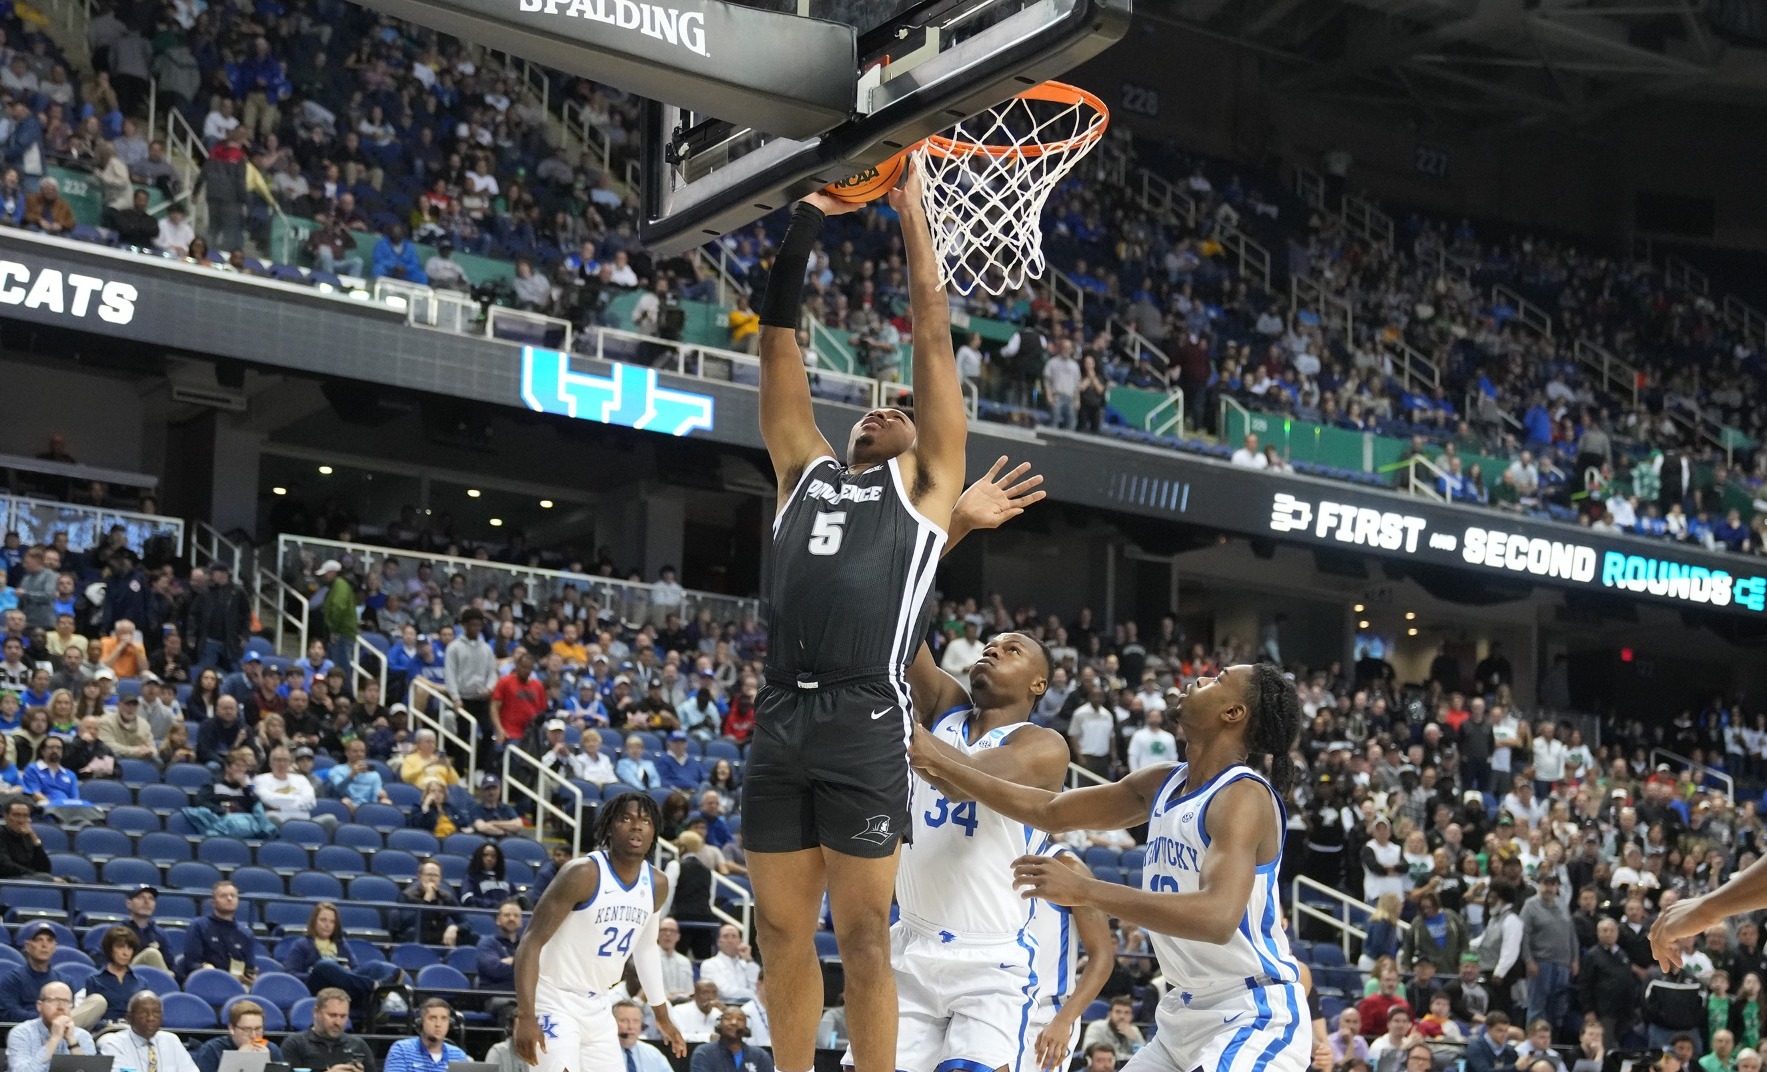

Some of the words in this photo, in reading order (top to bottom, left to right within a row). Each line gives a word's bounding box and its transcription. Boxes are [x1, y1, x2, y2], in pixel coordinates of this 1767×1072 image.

[1121, 84, 1159, 116] 228
[834, 166, 880, 189] NCAA
[0, 260, 138, 325] CATS
[808, 511, 847, 555] 5
[1316, 501, 1427, 553] FIRST
[1462, 527, 1597, 583] SECOND
[1602, 551, 1732, 606] ROUNDS
[923, 785, 979, 837] 34
[594, 905, 649, 927] KENTUCKY
[598, 926, 635, 957] 24
